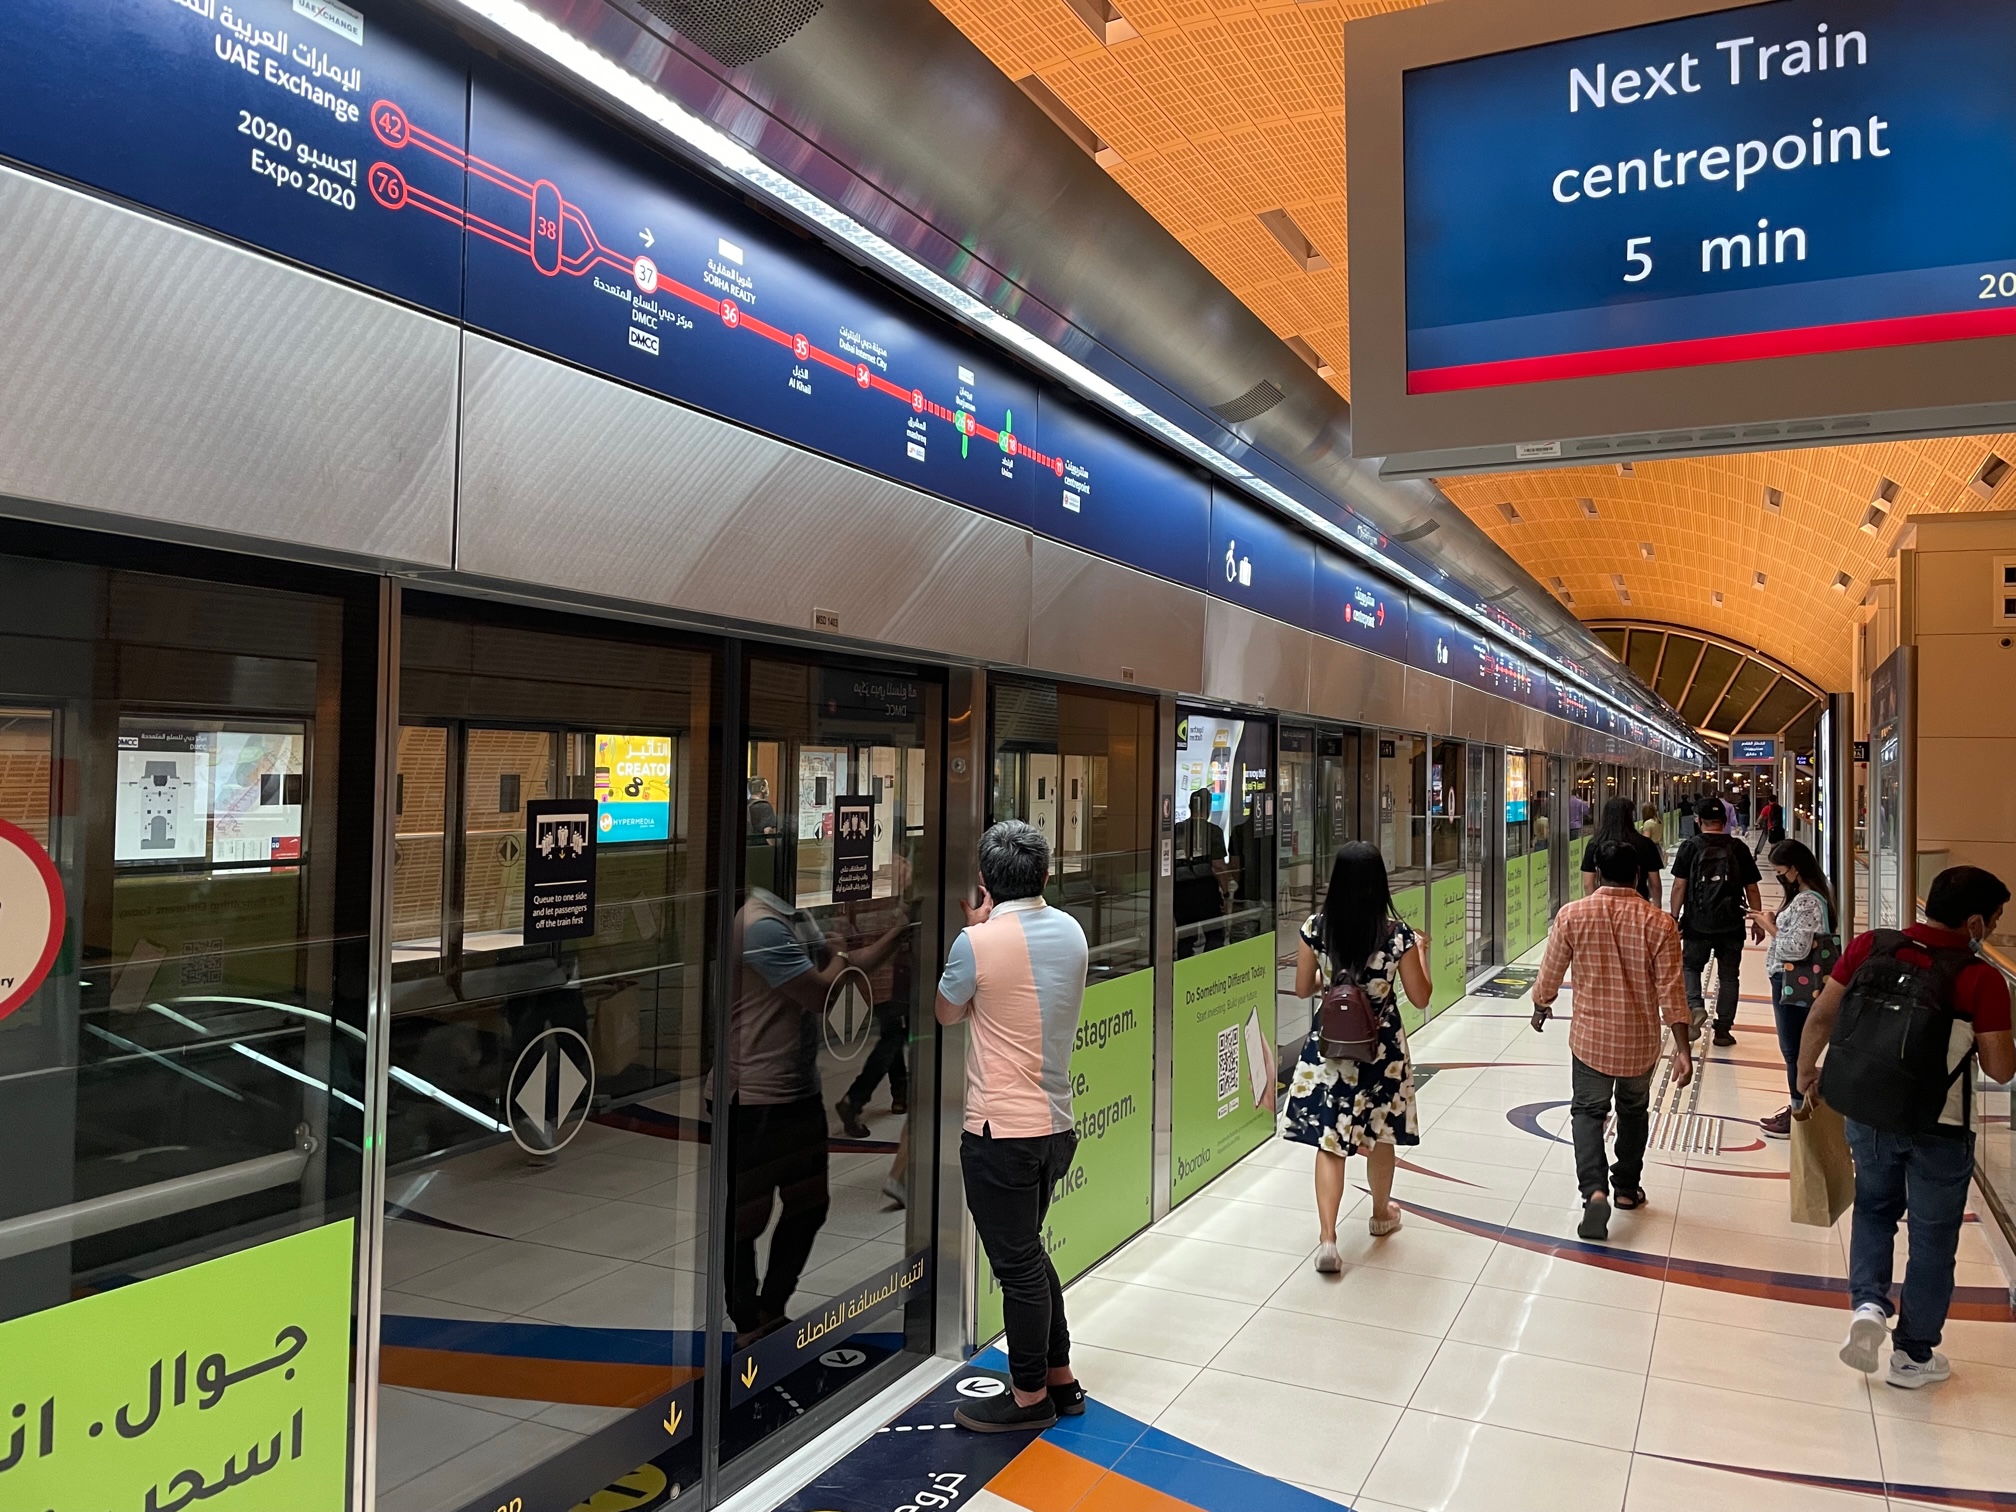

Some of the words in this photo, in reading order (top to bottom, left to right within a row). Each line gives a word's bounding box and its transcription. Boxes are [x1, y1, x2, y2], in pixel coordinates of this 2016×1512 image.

[220, 6, 288, 55] العربية
[216, 34, 260, 76] UAE
[265, 58, 359, 122] Exchange
[1570, 51, 1701, 113] Next
[1716, 22, 1868, 85] Train
[238, 110, 292, 151] 2020
[379, 113, 402, 139] 42
[297, 144, 357, 186] إكسبو
[1551, 115, 1891, 204] centrepoint
[252, 149, 303, 187] Expo
[307, 174, 356, 210] 2020
[377, 172, 399, 199] 76
[538, 217, 557, 240] 38
[1624, 236, 1653, 282] 5
[1702, 218, 1807, 273] min
[639, 265, 654, 285] 37
[704, 271, 730, 293] SOBHA
[730, 284, 756, 305] REALTY
[633, 295, 658, 314] للسلع
[659, 309, 676, 322] دبي
[724, 304, 737, 324] 36
[632, 309, 658, 330] DMCC
[676, 314, 693, 329] مركز
[631, 331, 658, 351] DMCC
[795, 339, 807, 355] 35
[839, 338, 855, 354] Dubai
[856, 346, 876, 365] Internet
[877, 357, 888, 372] City
[789, 377, 796, 389] Al
[797, 380, 812, 395] Khail
[858, 368, 869, 384] 34
[914, 394, 922, 409] 33
[613, 818, 655, 826] HYPERMEDIA
[533, 908, 545, 917] and
[546, 907, 554, 916] let
[555, 905, 588, 917] passengers
[534, 896, 555, 905] Queue
[563, 894, 575, 902] one
[575, 892, 588, 901] side
[536, 920, 545, 929] off
[546, 919, 557, 928] the
[557, 917, 571, 927] train
[572, 916, 584, 925] first
[1186, 991, 1196, 1005] Do
[1196, 980, 1227, 1001] Something
[1228, 973, 1250, 989] Different
[1251, 965, 1266, 979] Today.
[1185, 1148, 1211, 1177] baraka
[901, 1258, 924, 1289] انتبه
[848, 1272, 898, 1319] للمسافة
[796, 1302, 846, 1349] الفاصلة
[88, 1325, 308, 1439] جوال.
